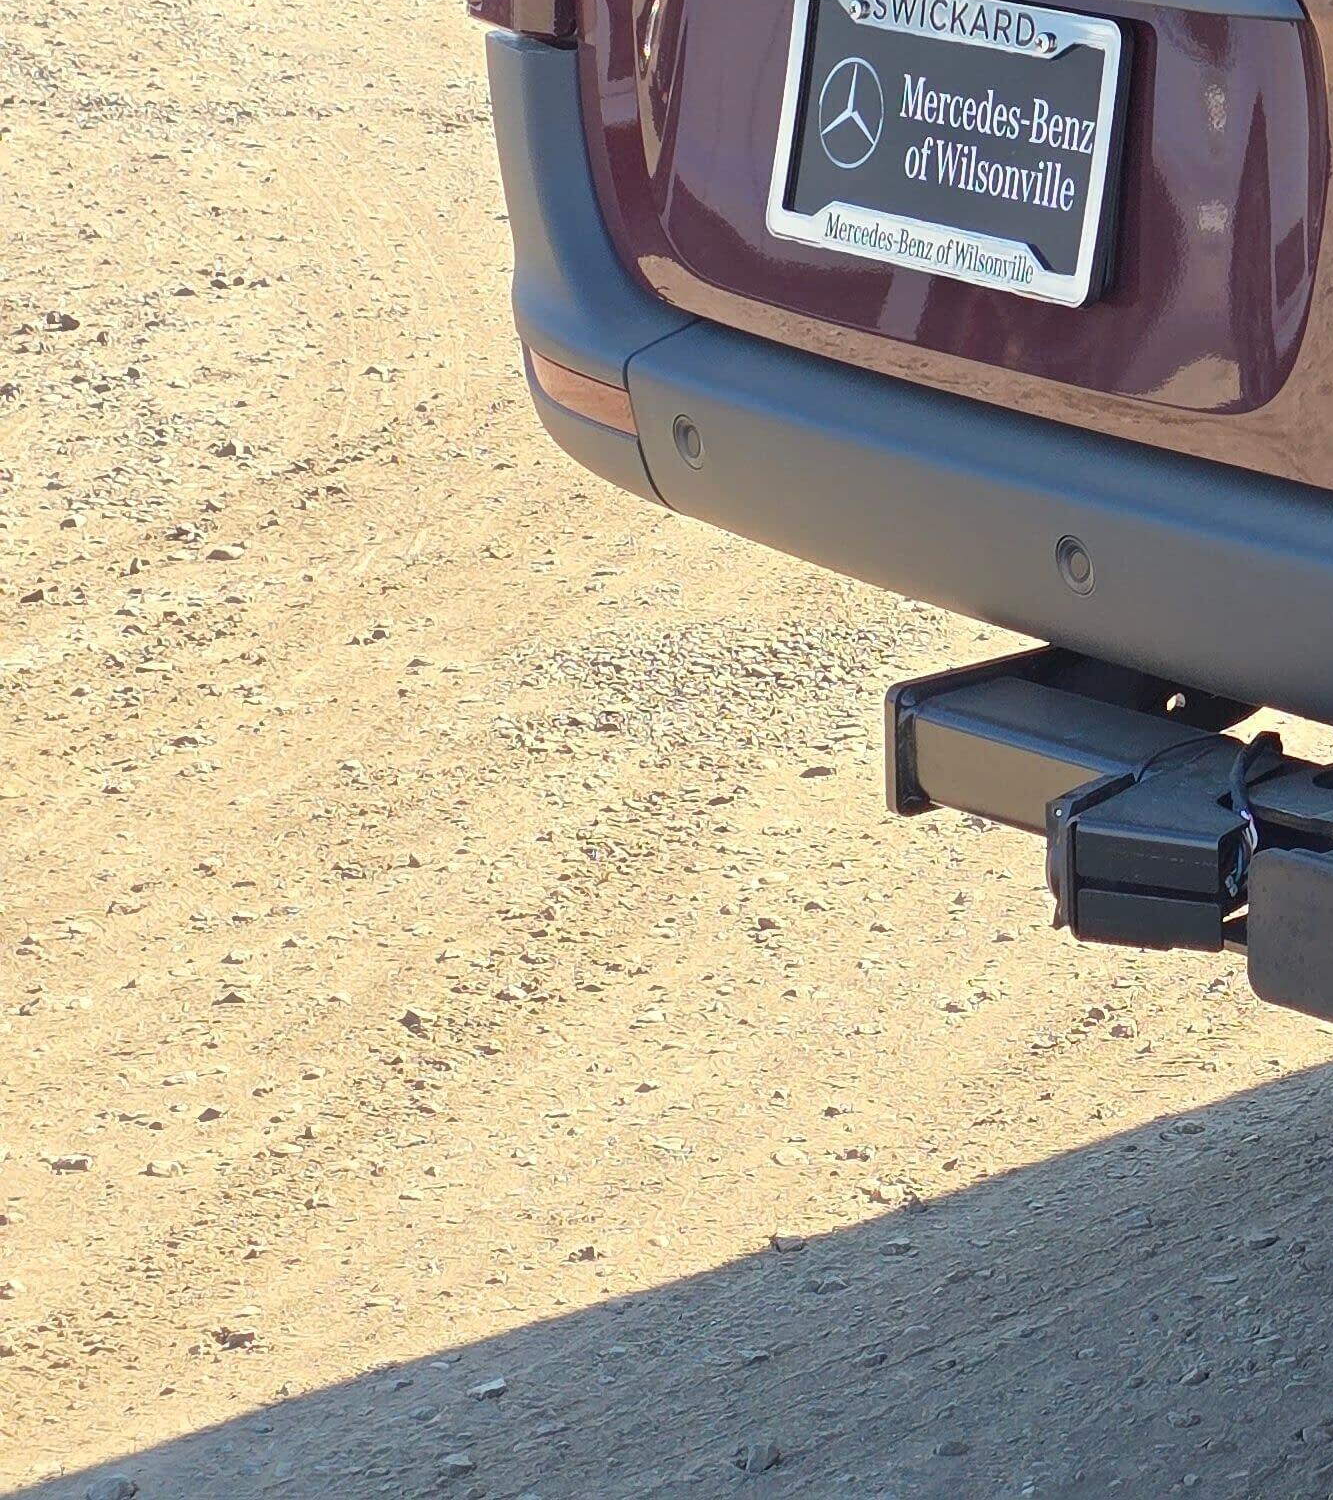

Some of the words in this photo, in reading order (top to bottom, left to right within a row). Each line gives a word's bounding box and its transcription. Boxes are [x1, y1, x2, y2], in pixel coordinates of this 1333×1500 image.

[899, 73, 1096, 155] Mercedes-Benz
[904, 136, 934, 181] of
[936, 138, 1076, 212] Wilsonville
[824, 211, 933, 264] Mercedes-Benz
[936, 239, 953, 264] of
[953, 240, 1035, 285] Wilsonville
